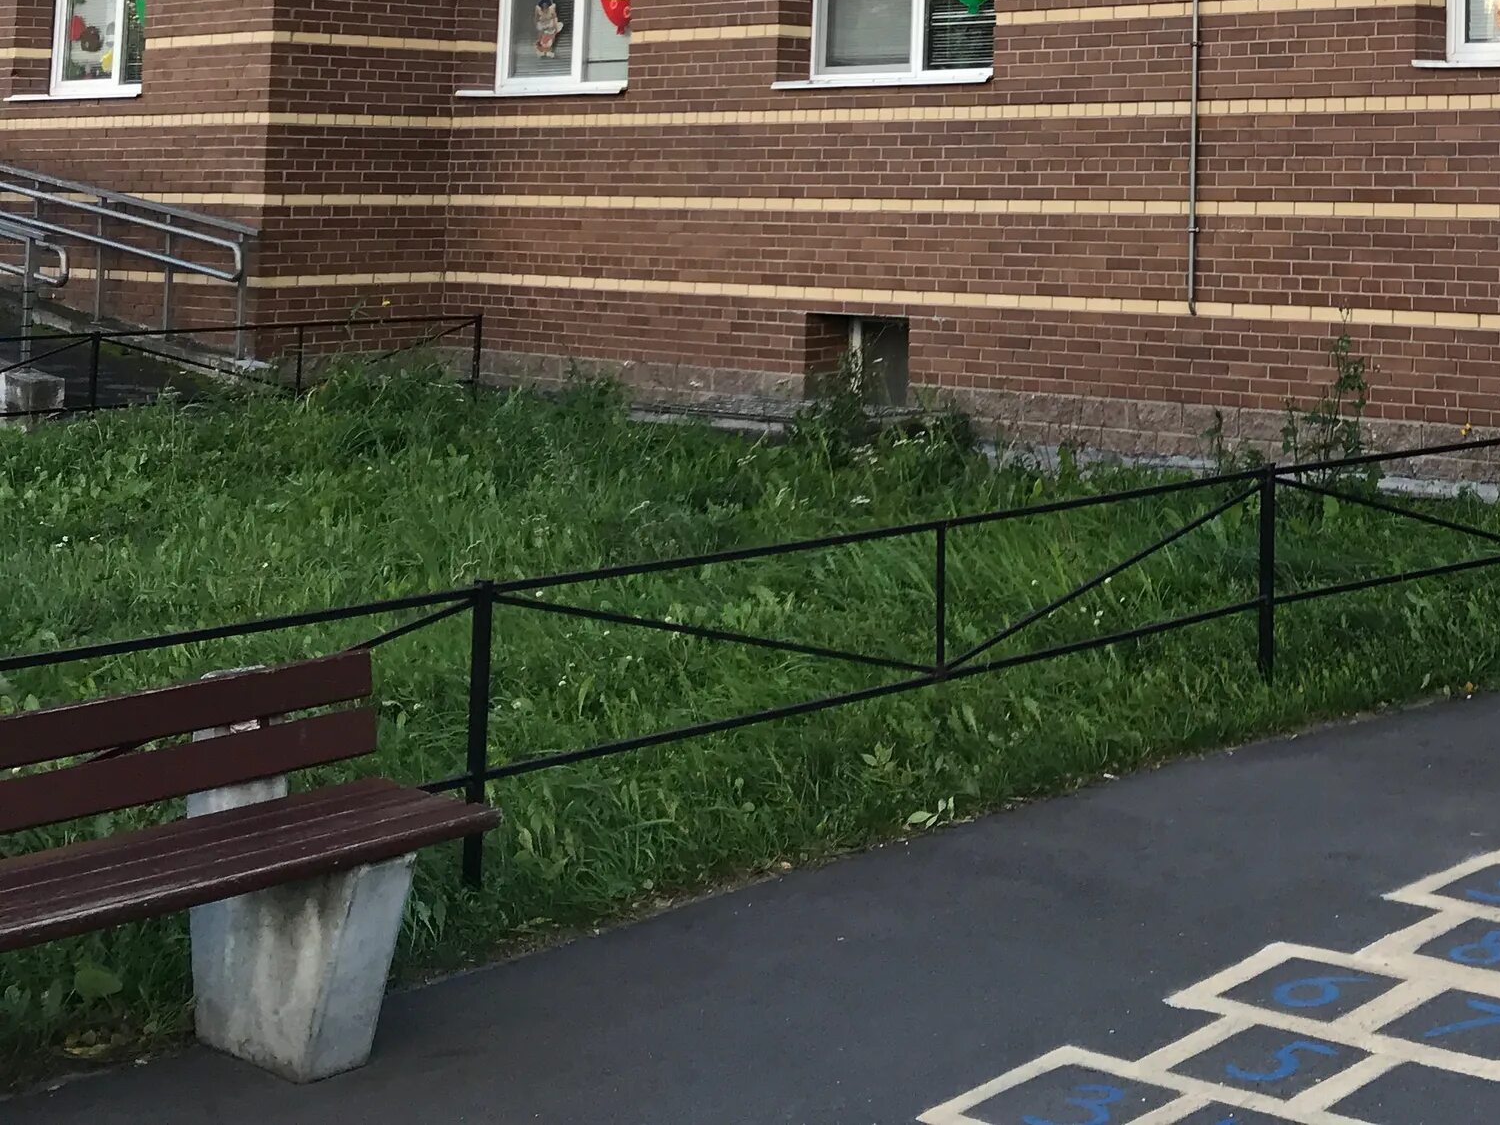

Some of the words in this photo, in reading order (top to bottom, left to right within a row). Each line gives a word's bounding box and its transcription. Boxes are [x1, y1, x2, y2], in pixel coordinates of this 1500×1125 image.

[1272, 976, 1371, 1008] 6
[1225, 1040, 1340, 1081] 5
[1023, 1083, 1126, 1125] 3
